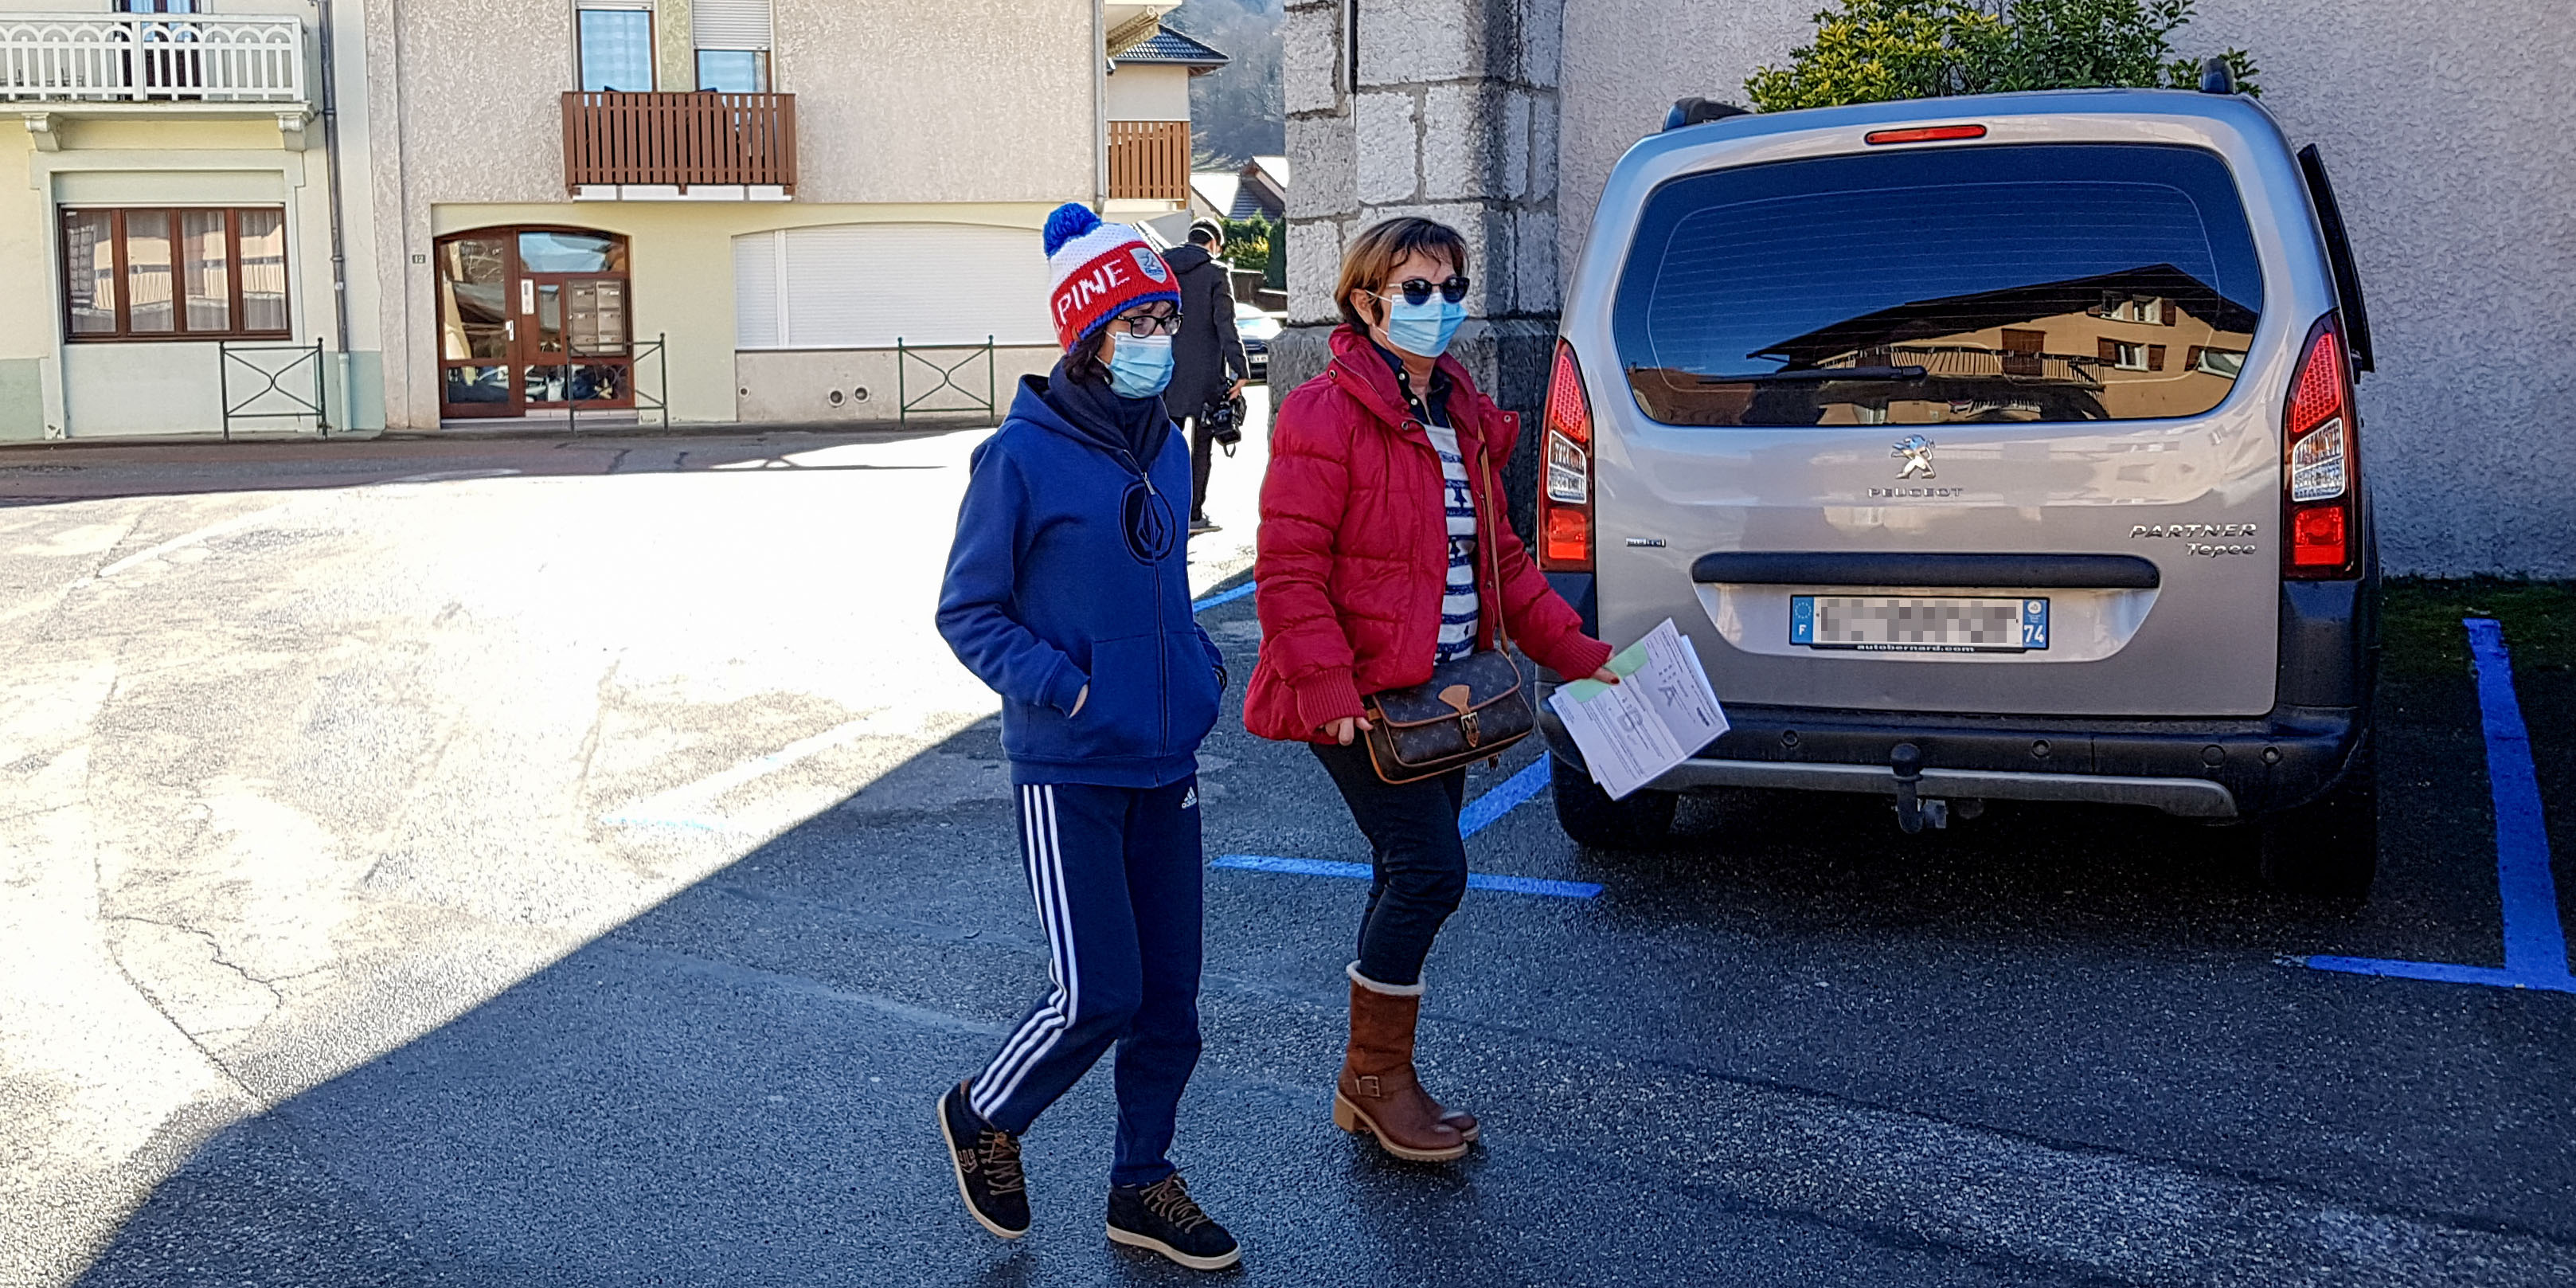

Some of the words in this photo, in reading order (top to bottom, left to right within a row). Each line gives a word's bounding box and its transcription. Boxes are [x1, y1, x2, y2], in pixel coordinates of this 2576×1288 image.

[1867, 487, 1964, 498] PEUGEOT
[2128, 523, 2257, 538] PARTNER
[2186, 542, 2257, 558] Tepee
[1799, 624, 1807, 636] F
[2023, 624, 2045, 643] 74
[1856, 643, 1976, 653] autobernard.com
